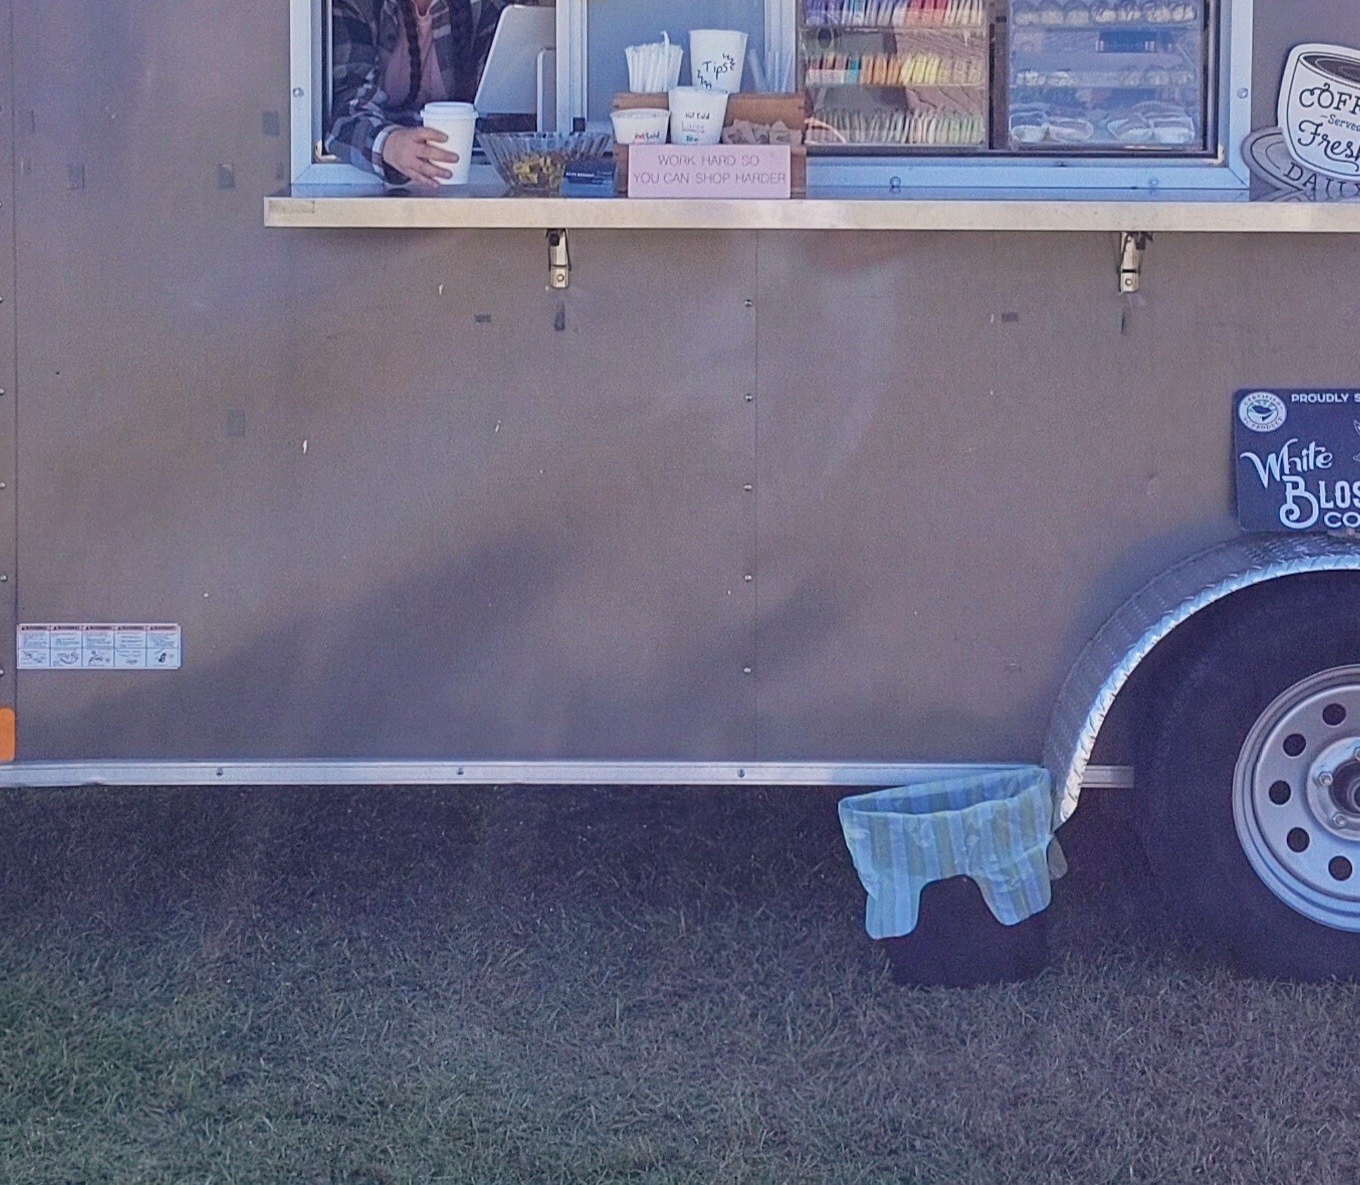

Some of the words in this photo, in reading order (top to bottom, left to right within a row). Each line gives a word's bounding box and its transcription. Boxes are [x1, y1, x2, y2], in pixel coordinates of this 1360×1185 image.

[702, 60, 729, 80] Tips
[658, 155, 695, 166] WORK
[702, 155, 736, 166] HARD
[741, 155, 760, 166] SO
[633, 172, 660, 185] YOU
[664, 172, 689, 185] CAN
[695, 172, 730, 185] SHOP
[735, 172, 786, 185] HARDER
[1291, 393, 1348, 403] PROUDLY
[1240, 438, 1333, 490] White
